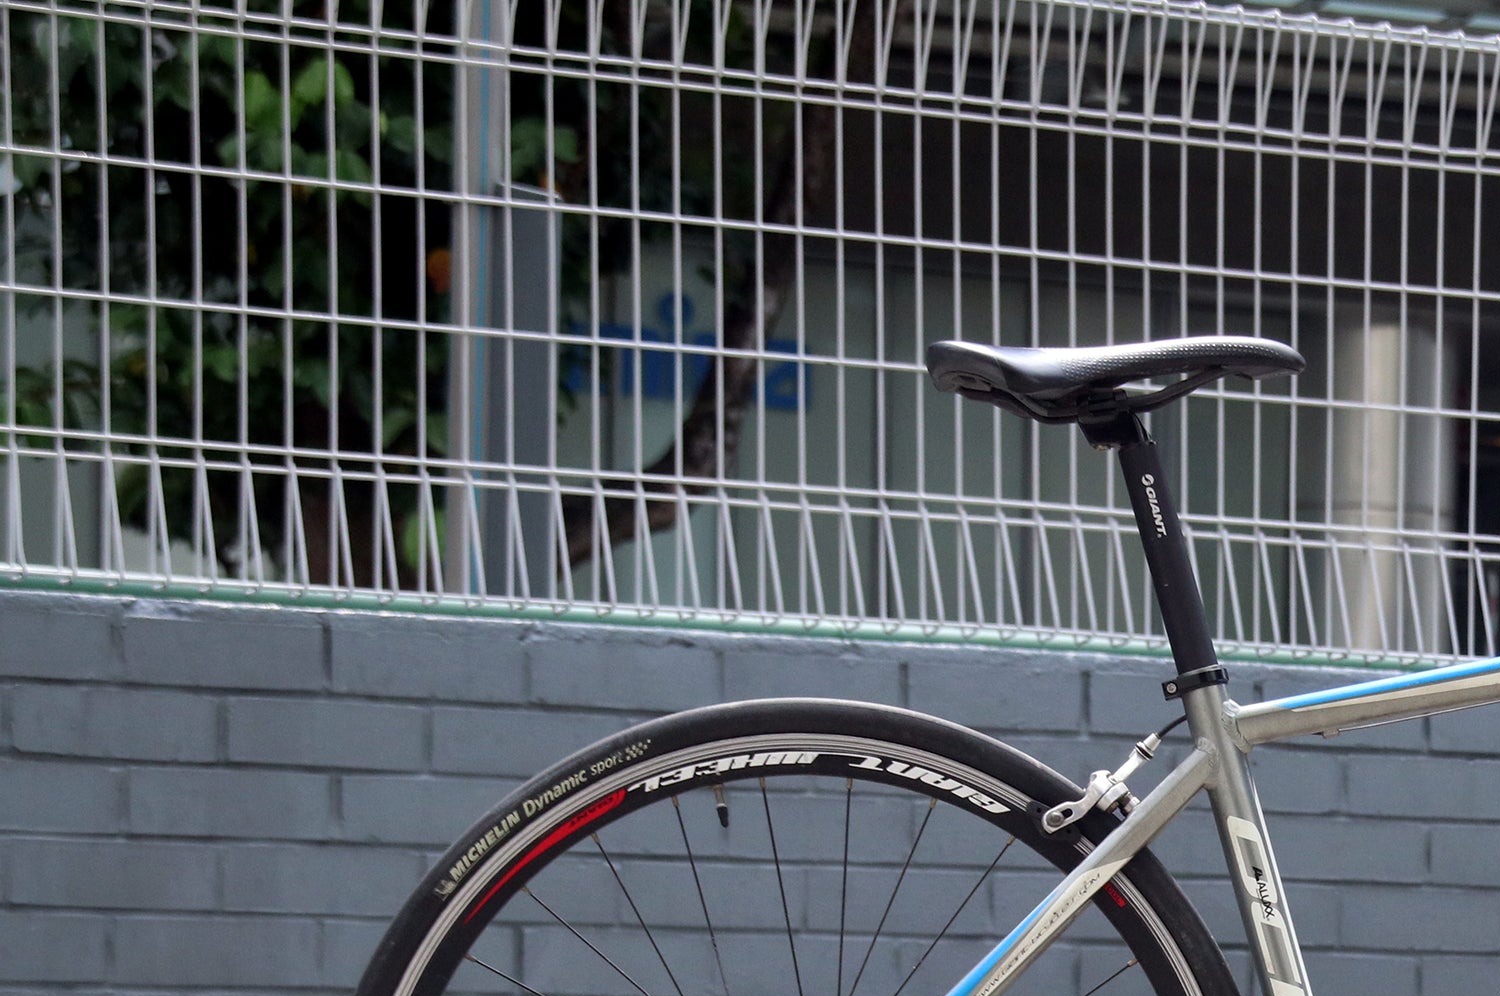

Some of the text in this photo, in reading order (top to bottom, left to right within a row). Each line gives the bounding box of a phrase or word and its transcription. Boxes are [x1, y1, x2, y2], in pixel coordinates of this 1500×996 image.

[1146, 487, 1167, 537] GIANT
[848, 755, 1011, 814] GIANT
[449, 752, 624, 883] MICHELIN Dynamic sport
[1257, 881, 1276, 919] ALUXX
